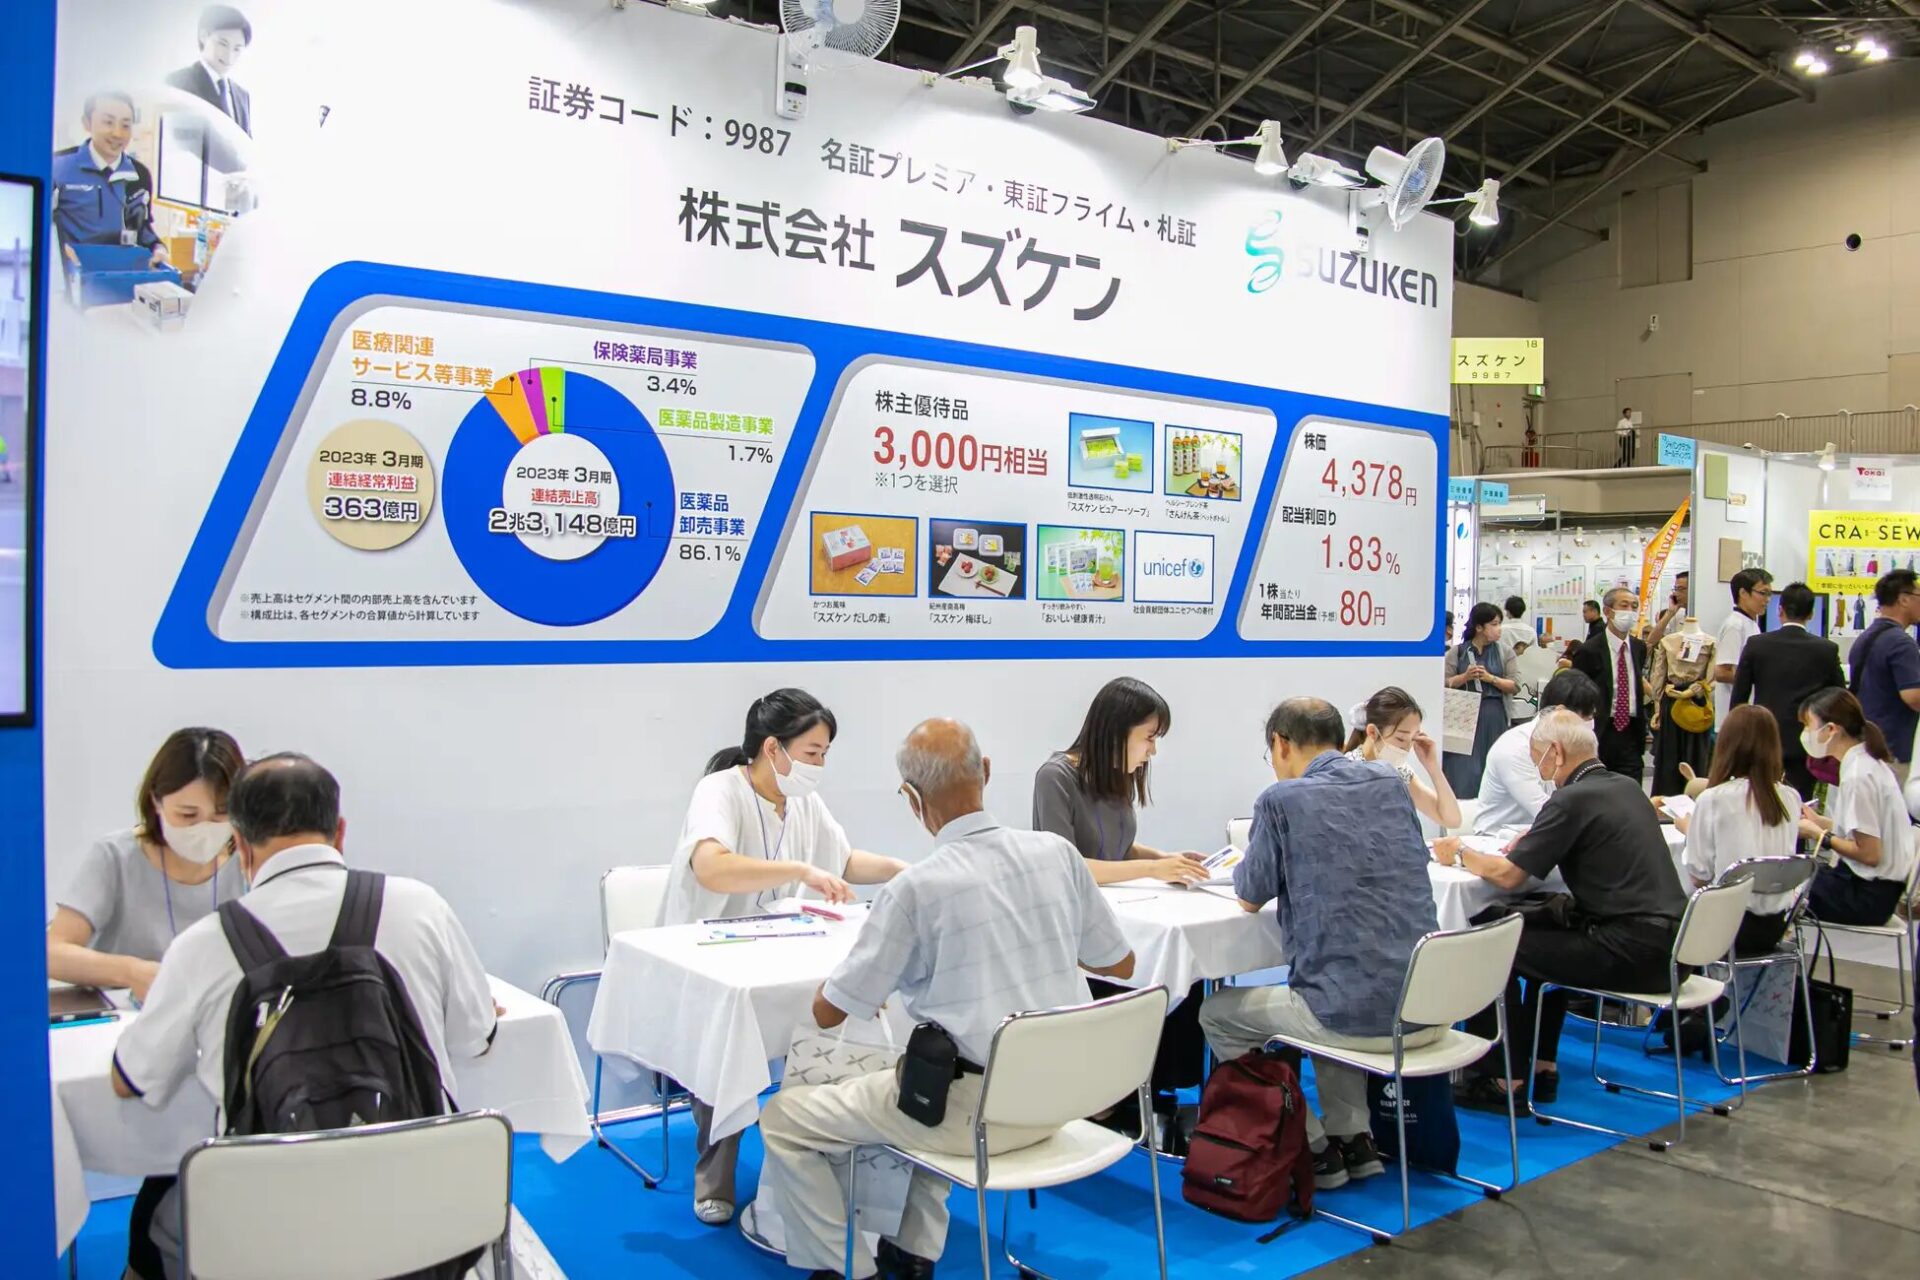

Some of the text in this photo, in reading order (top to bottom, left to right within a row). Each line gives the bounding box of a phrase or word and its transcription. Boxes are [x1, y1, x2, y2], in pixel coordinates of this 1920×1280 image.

[679, 187, 1121, 321] 株式会社 スズケン
[352, 329, 434, 357] 医療関連
[1526, 340, 1538, 348] 18
[593, 340, 698, 369] 保険薬局事業
[1457, 354, 1526, 367] スズケン
[352, 357, 493, 388] サービス等事業
[1472, 371, 1511, 379] 9987
[647, 375, 697, 396] 3.4%
[351, 388, 412, 410] 8.8%
[875, 389, 969, 421] 株主優待品
[658, 408, 773, 436] 医薬品製造事業
[873, 426, 1048, 476] 3,000円相当
[1304, 432, 1327, 451] 株価
[319, 450, 424, 469] 2023年 3月期
[728, 445, 773, 464] 1.7%
[328, 472, 415, 490] 連結経常利益
[516, 466, 612, 484] 2023年 3月期
[1321, 458, 1417, 507] 4,378円
[531, 488, 597, 505] 連結売上高
[679, 492, 730, 512] 医薬品
[324, 496, 418, 521] 363億円
[1282, 506, 1337, 526] 配当利回り
[490, 510, 636, 536] 2兆3,148億円
[679, 515, 746, 536] 卸売事業
[679, 544, 741, 562] 86.1%
[1321, 534, 1400, 575] 1.83%
[1143, 557, 1188, 577] unicef
[813, 601, 846, 609] かつお風味
[1340, 590, 1386, 626] 80円
